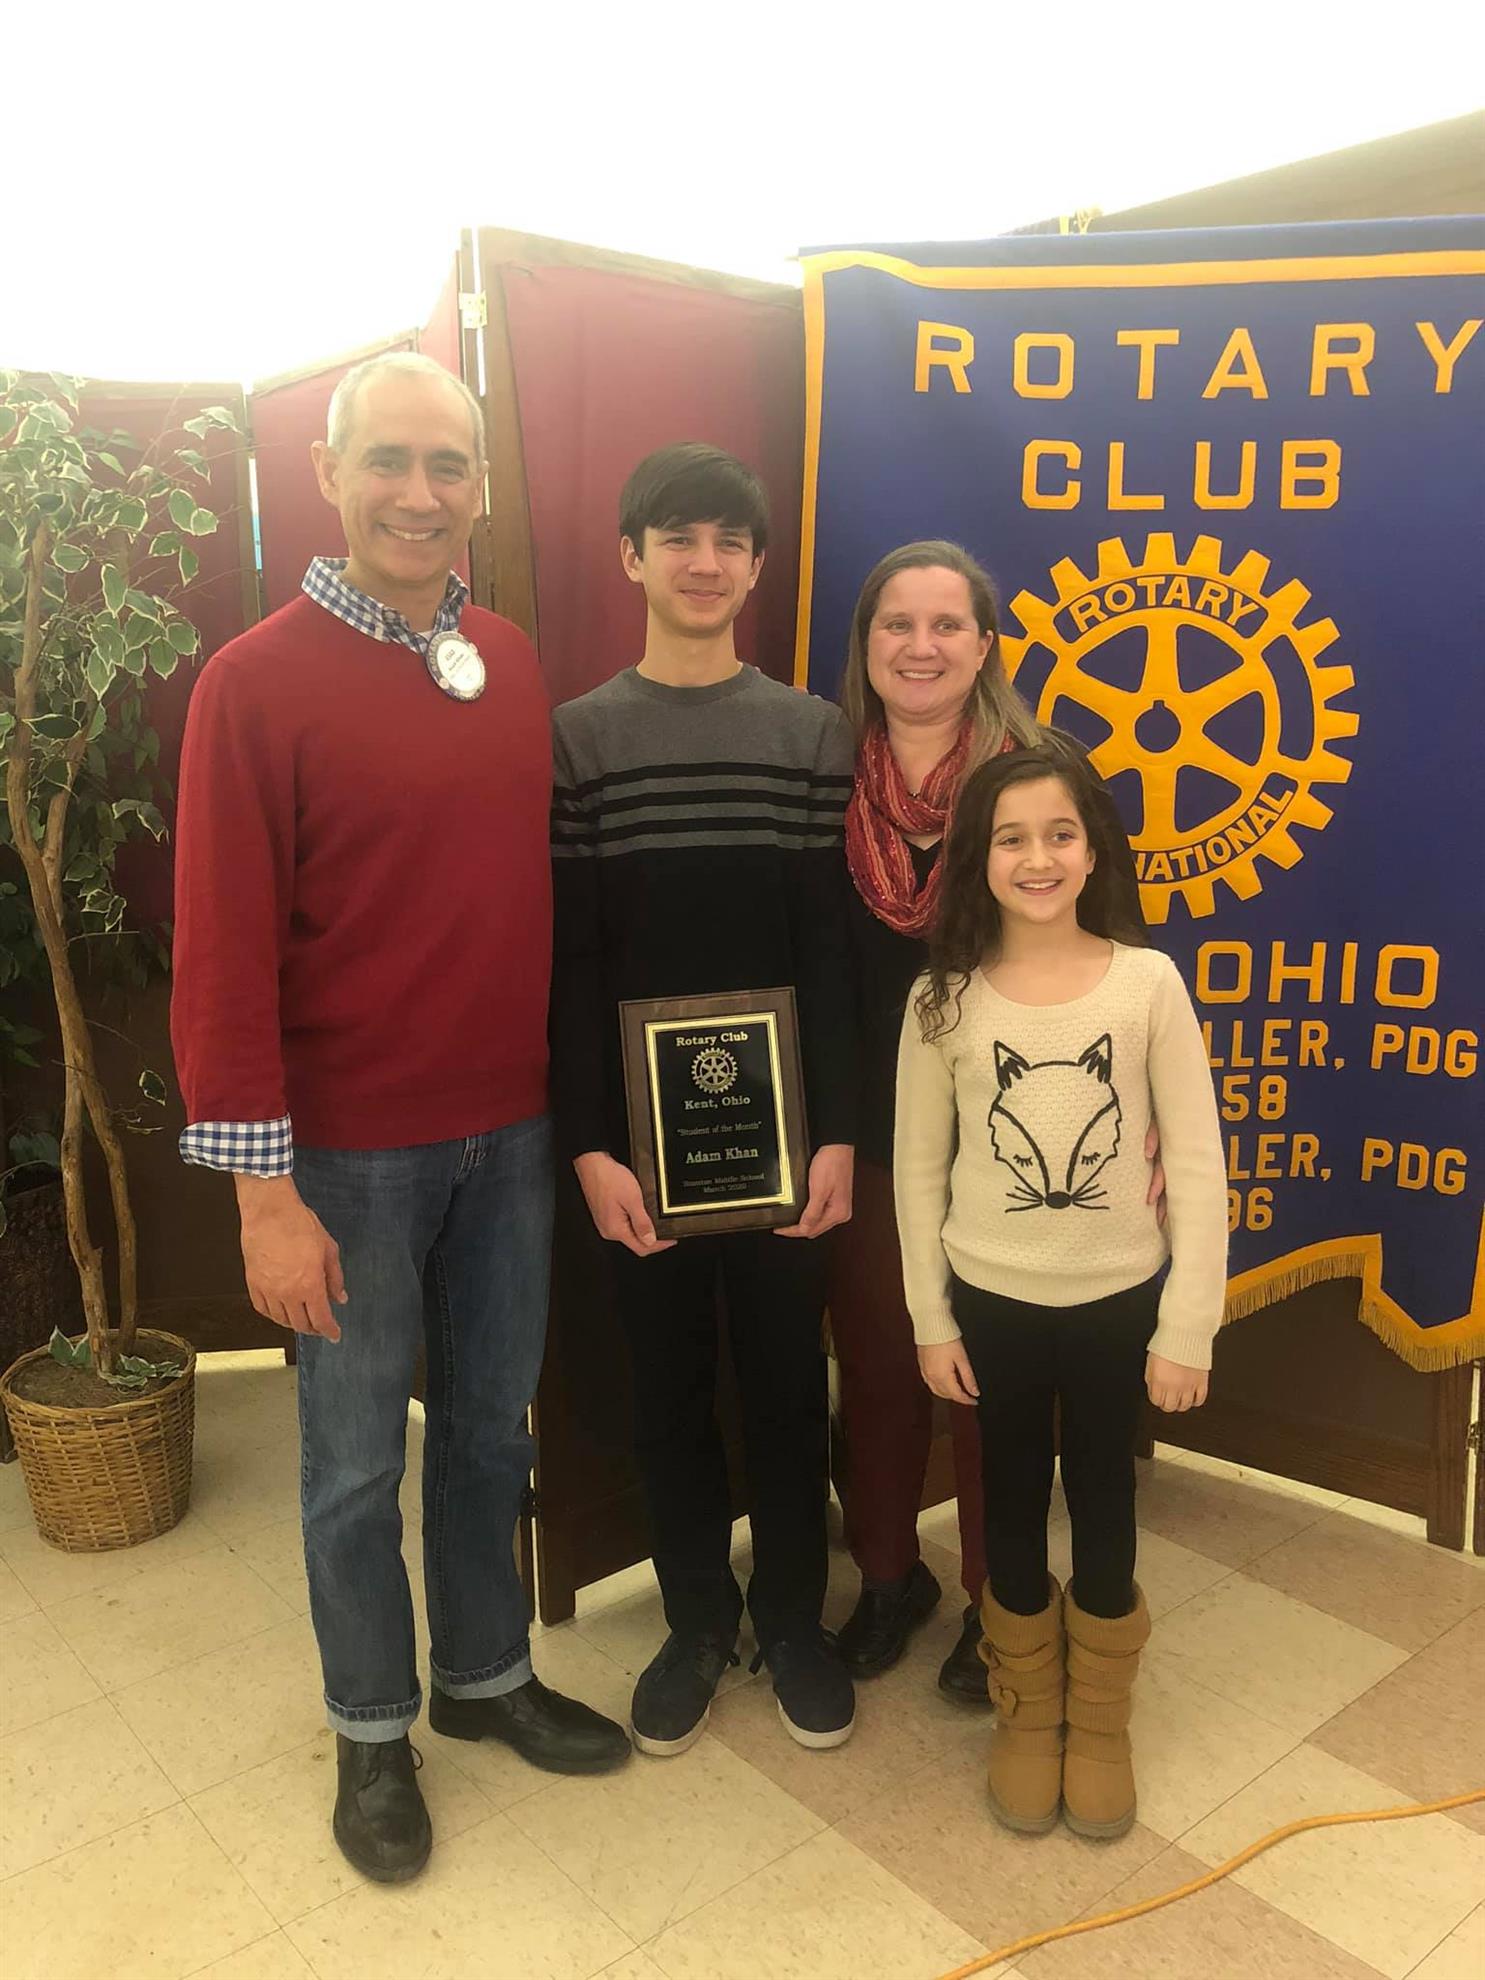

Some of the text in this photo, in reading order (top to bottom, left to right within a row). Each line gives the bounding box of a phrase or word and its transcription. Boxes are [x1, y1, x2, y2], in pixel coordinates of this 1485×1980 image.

[914, 319, 1483, 399] ROTARY
[1022, 439, 1342, 510] CLUB
[1068, 576, 1260, 633] ROTARY
[1196, 941, 1440, 1009] OHIO
[676, 1031, 749, 1047] Rotary Club
[1371, 1023, 1478, 1078] PDG
[684, 1095, 751, 1110] Kent, Ohio
[1222, 1074, 1288, 1121] 58
[686, 1147, 759, 1164] Adam Khan
[1361, 1137, 1467, 1195] PDG
